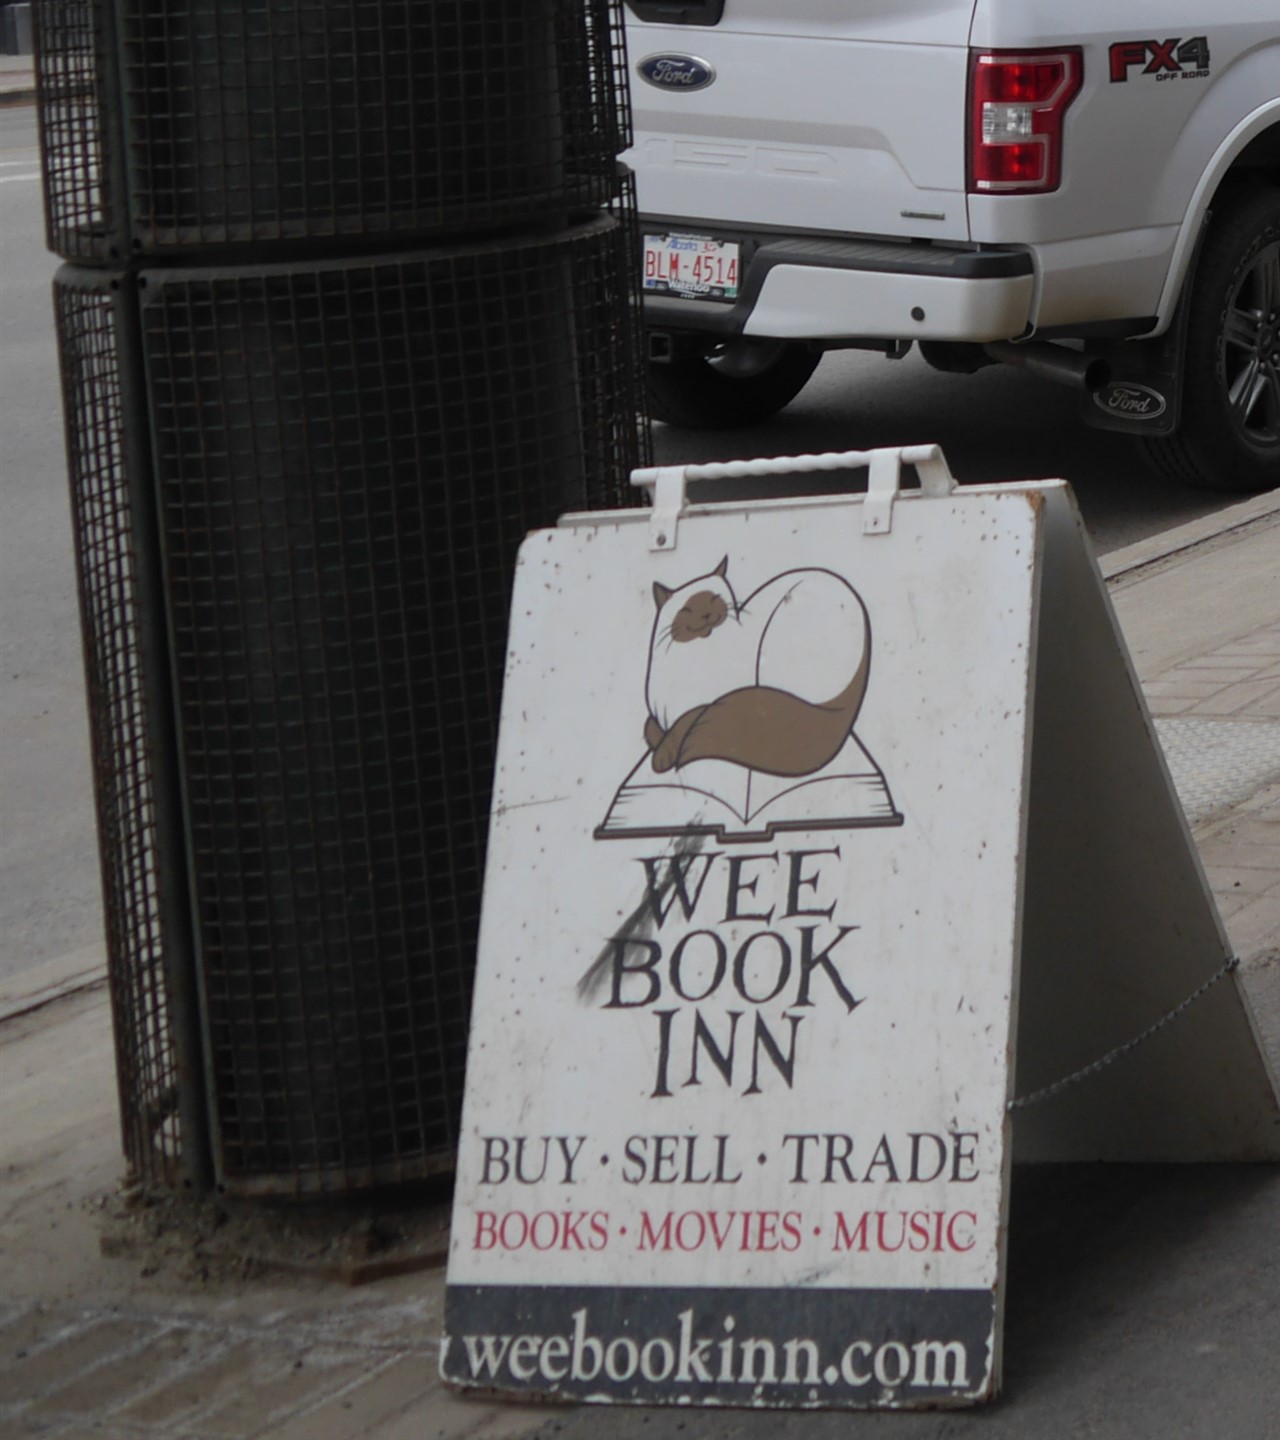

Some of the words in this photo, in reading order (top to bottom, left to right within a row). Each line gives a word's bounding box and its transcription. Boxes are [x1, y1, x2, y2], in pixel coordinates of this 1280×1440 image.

[652, 59, 696, 84] Ford
[1108, 36, 1211, 83] FX4
[1155, 72, 1178, 81] OFF
[1181, 69, 1211, 80] ROAD
[645, 250, 738, 286] BLM-4514
[1108, 387, 1152, 413] Ford
[632, 845, 842, 929] WEE
[600, 924, 868, 1015] BOOK
[648, 1007, 804, 1098] INN
[479, 1135, 588, 1186] BUY
[621, 1134, 744, 1186] SELL
[781, 1130, 981, 1186] TRADE
[472, 1210, 610, 1251] BOOKS
[637, 1210, 803, 1252] MOVIES
[832, 1210, 979, 1252] MUSIC
[462, 1307, 972, 1387] weebookinn.com
